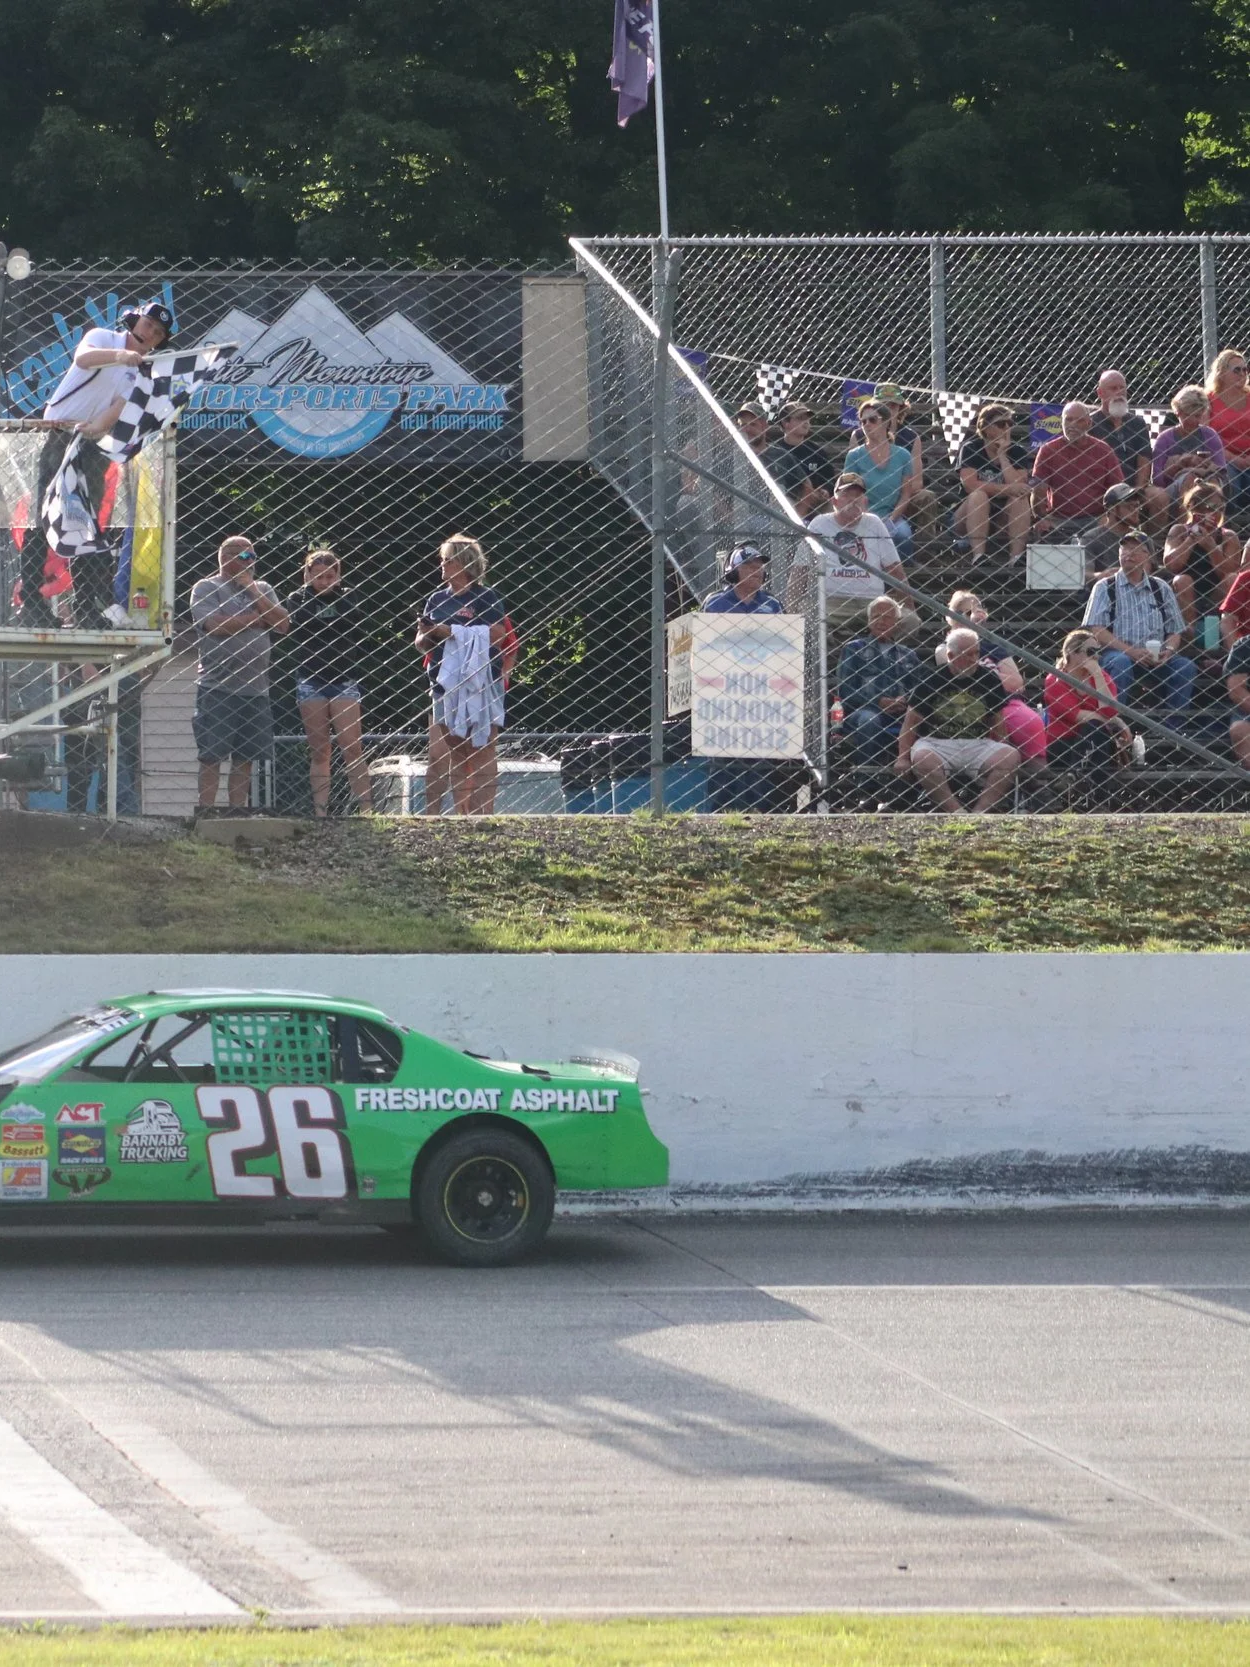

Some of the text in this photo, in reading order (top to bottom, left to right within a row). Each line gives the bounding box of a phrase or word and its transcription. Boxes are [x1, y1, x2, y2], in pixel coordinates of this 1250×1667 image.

[263, 337, 434, 387] Mountain
[188, 384, 402, 411] TORSPORTS
[405, 384, 510, 411] PARK
[401, 413, 504, 431] NEW HAMPSHIRE
[355, 1087, 620, 1113] FRESHCOAT ASPHALT
[3, 1145, 44, 1156] Bassett
[122, 1134, 185, 1147] BARNABY
[196, 1084, 349, 1200] 26
[120, 1147, 188, 1159] TRUCKING
